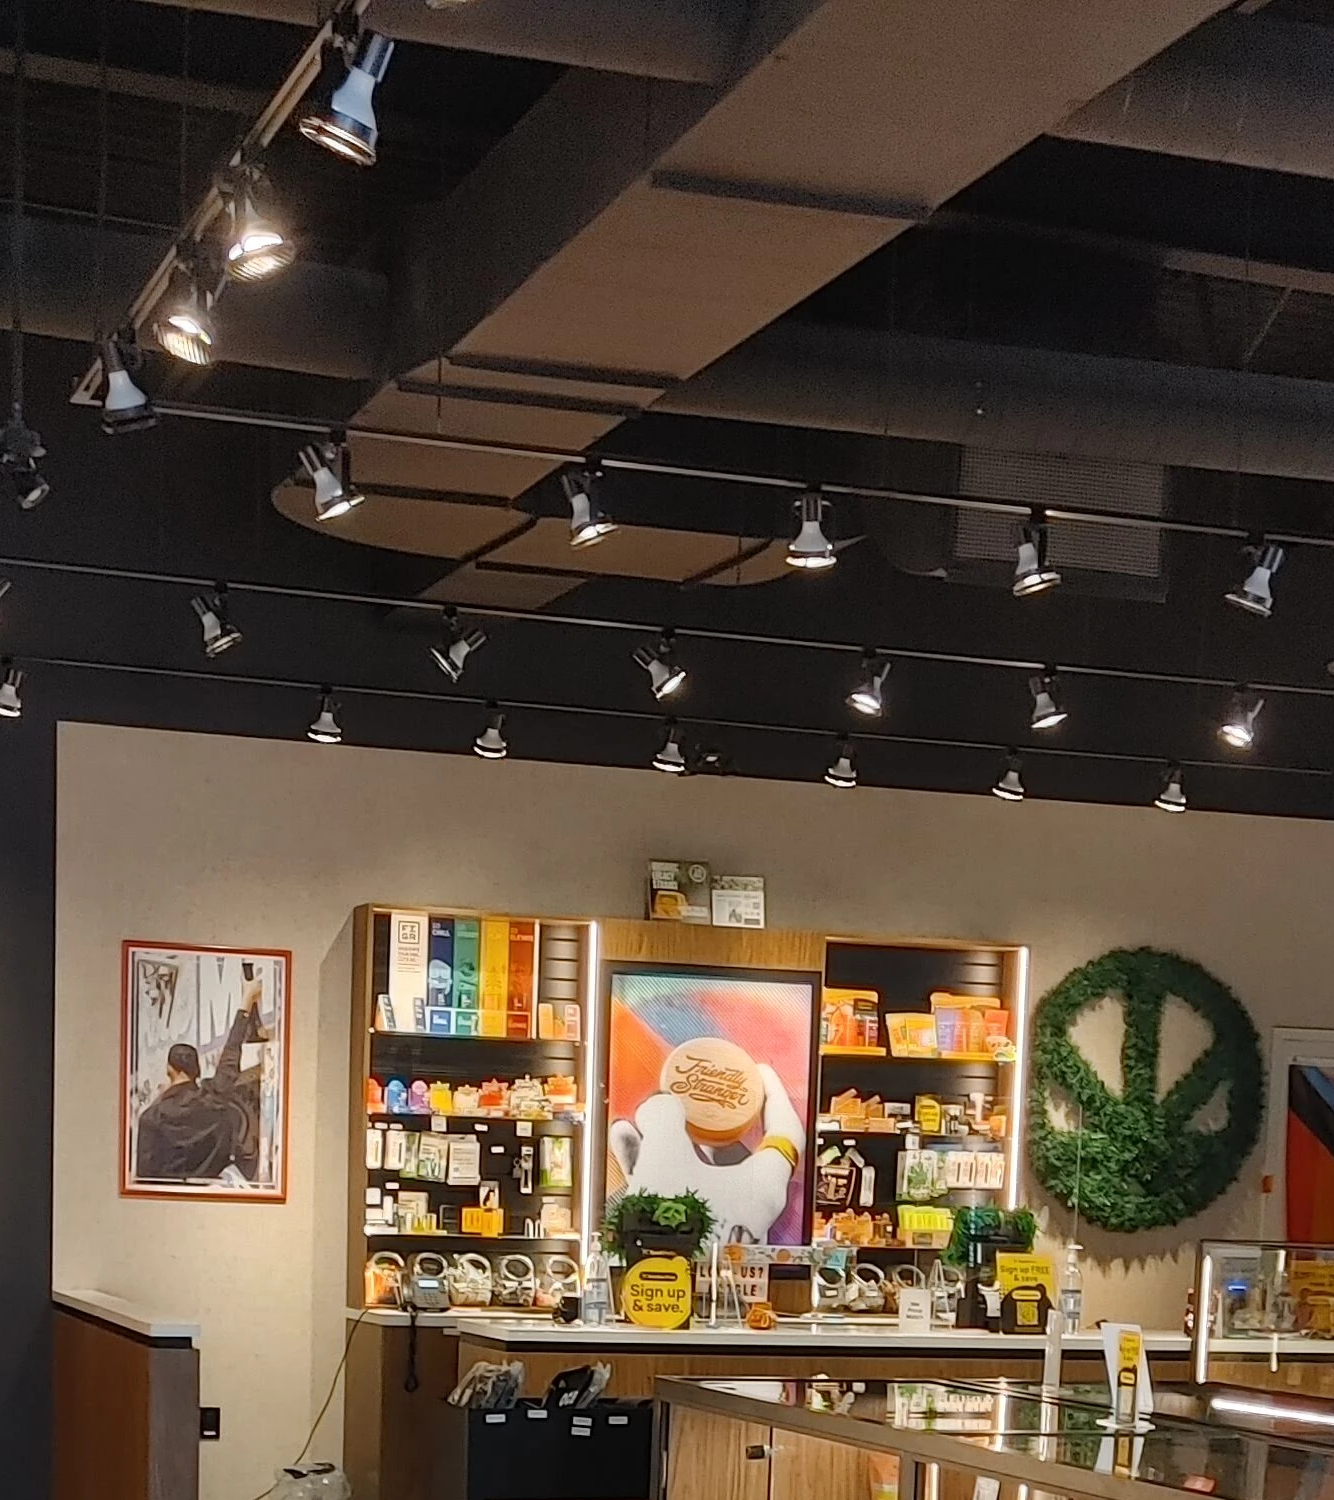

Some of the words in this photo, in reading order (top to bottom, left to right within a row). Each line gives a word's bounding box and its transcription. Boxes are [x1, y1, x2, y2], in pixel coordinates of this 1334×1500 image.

[675, 1055, 749, 1092] Friendly
[670, 1073, 750, 1110] Stranger
[741, 1266, 764, 1278] US?
[630, 1284, 664, 1301] Sign
[667, 1287, 686, 1299] up
[632, 1300, 644, 1312] &
[647, 1302, 684, 1313] save.
